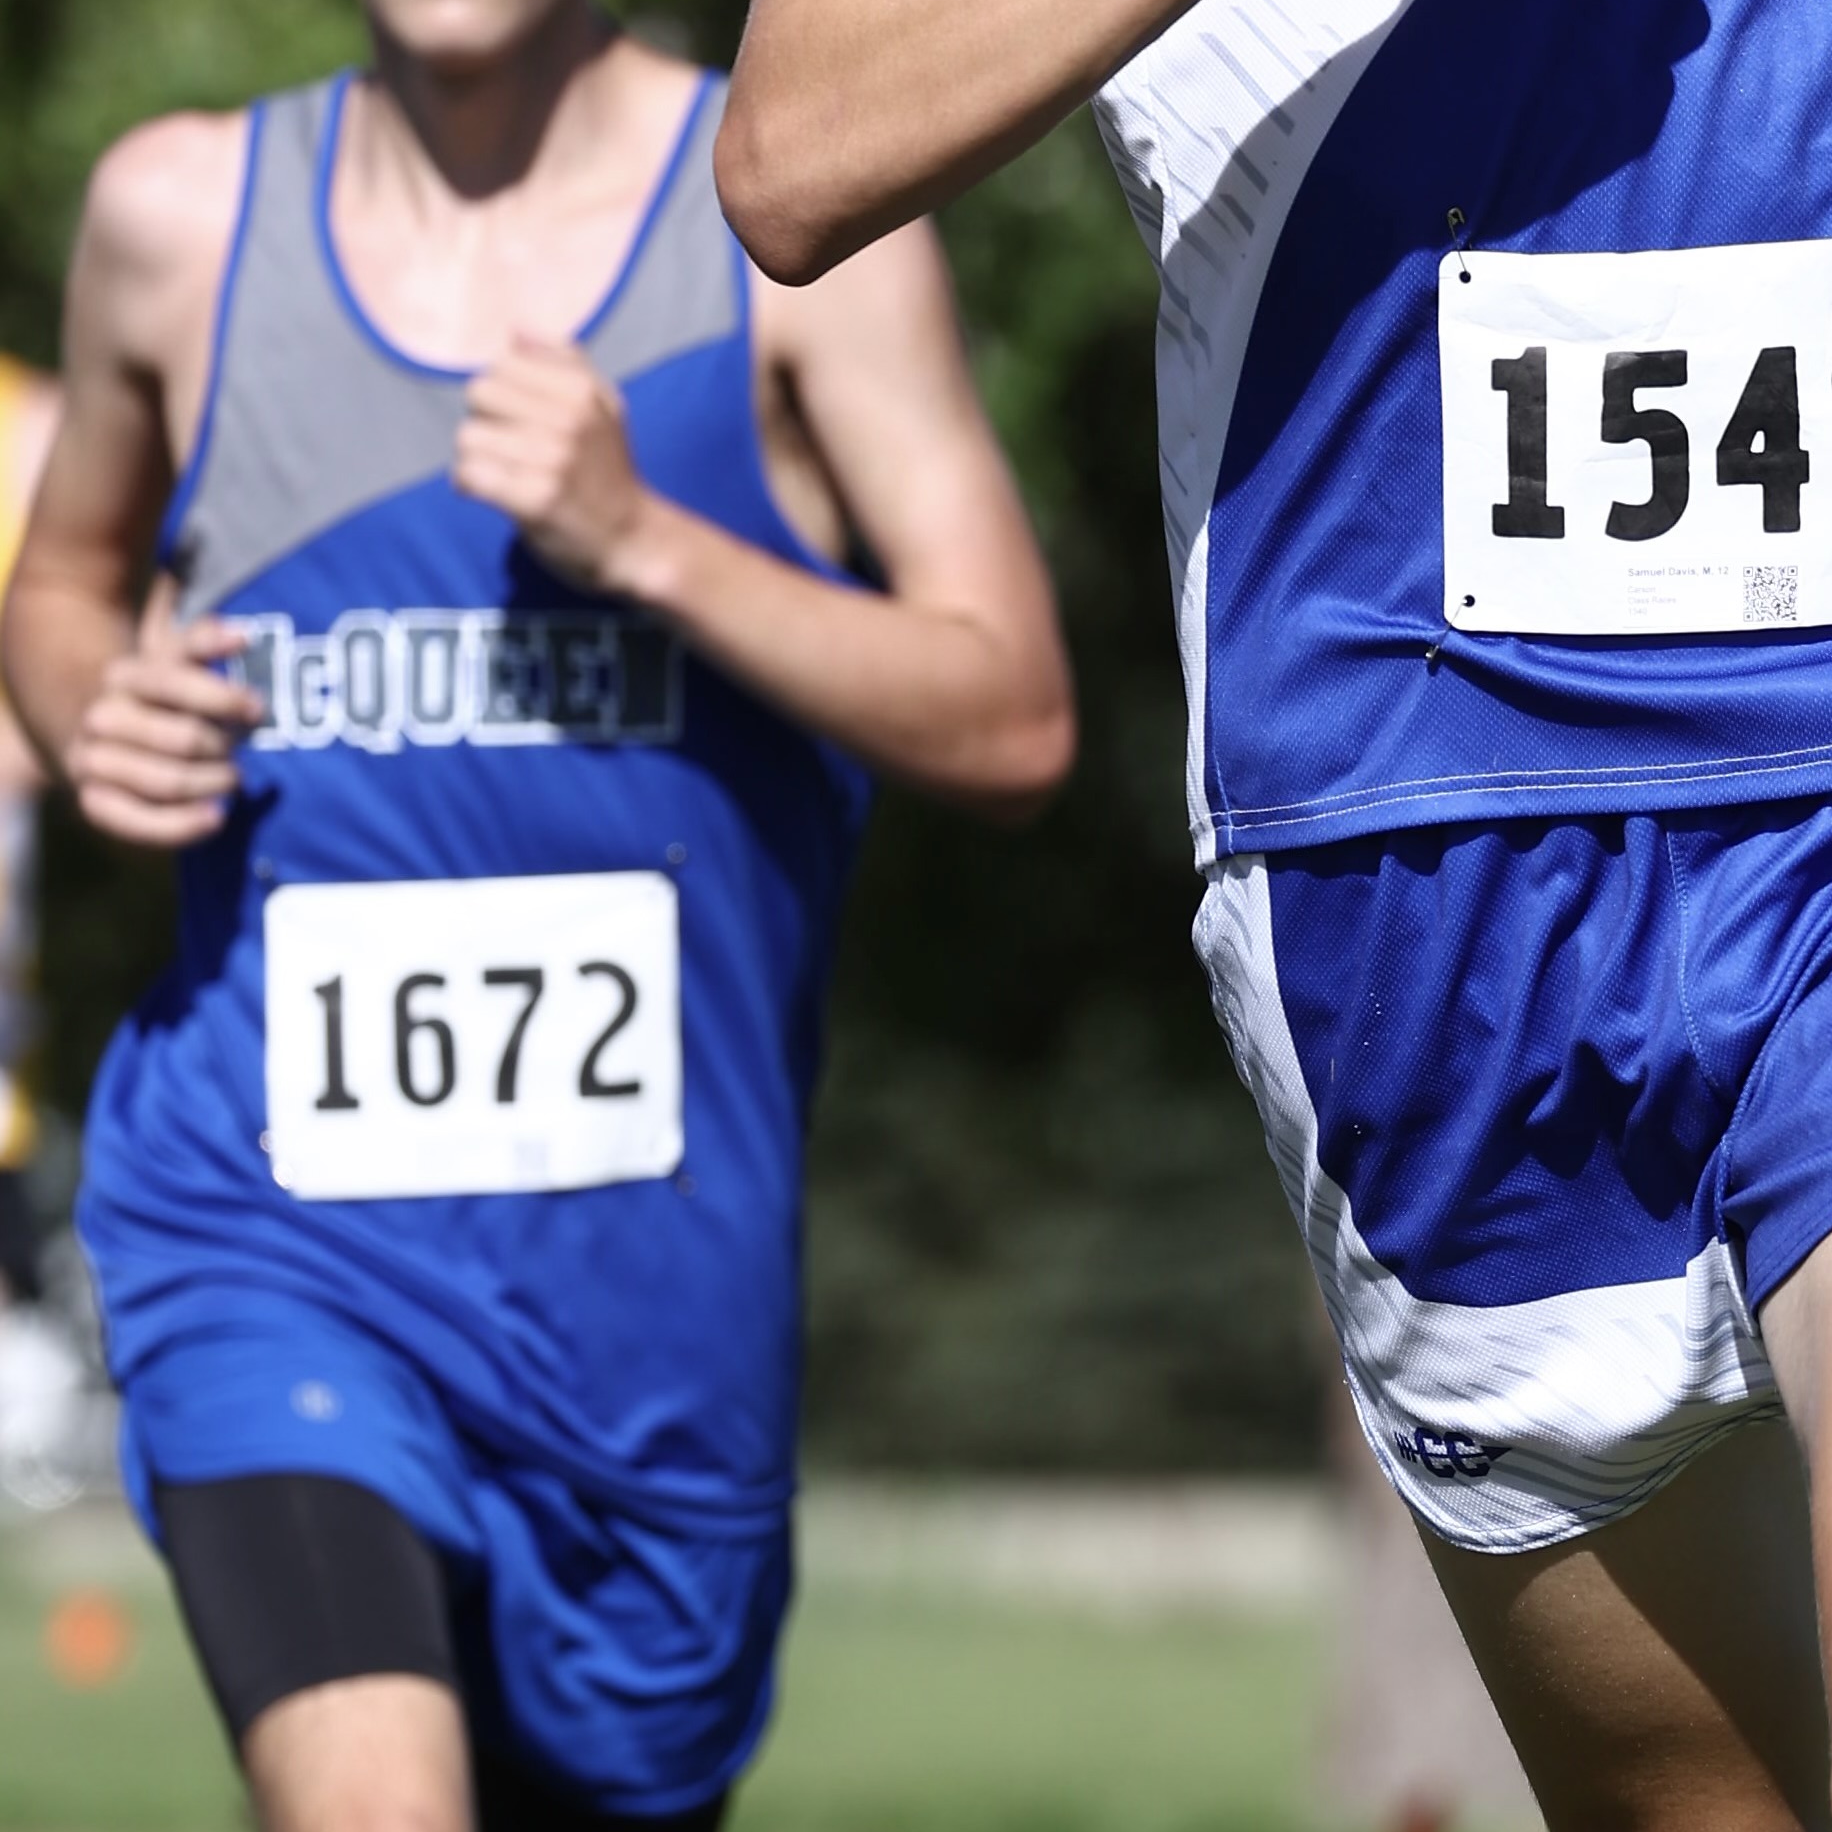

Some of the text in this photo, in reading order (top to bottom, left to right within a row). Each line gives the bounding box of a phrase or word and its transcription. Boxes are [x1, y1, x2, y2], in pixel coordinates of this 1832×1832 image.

[1627, 567, 1665, 577] Samuel
[1718, 566, 1729, 575] 12
[312, 961, 642, 1110] 1672
